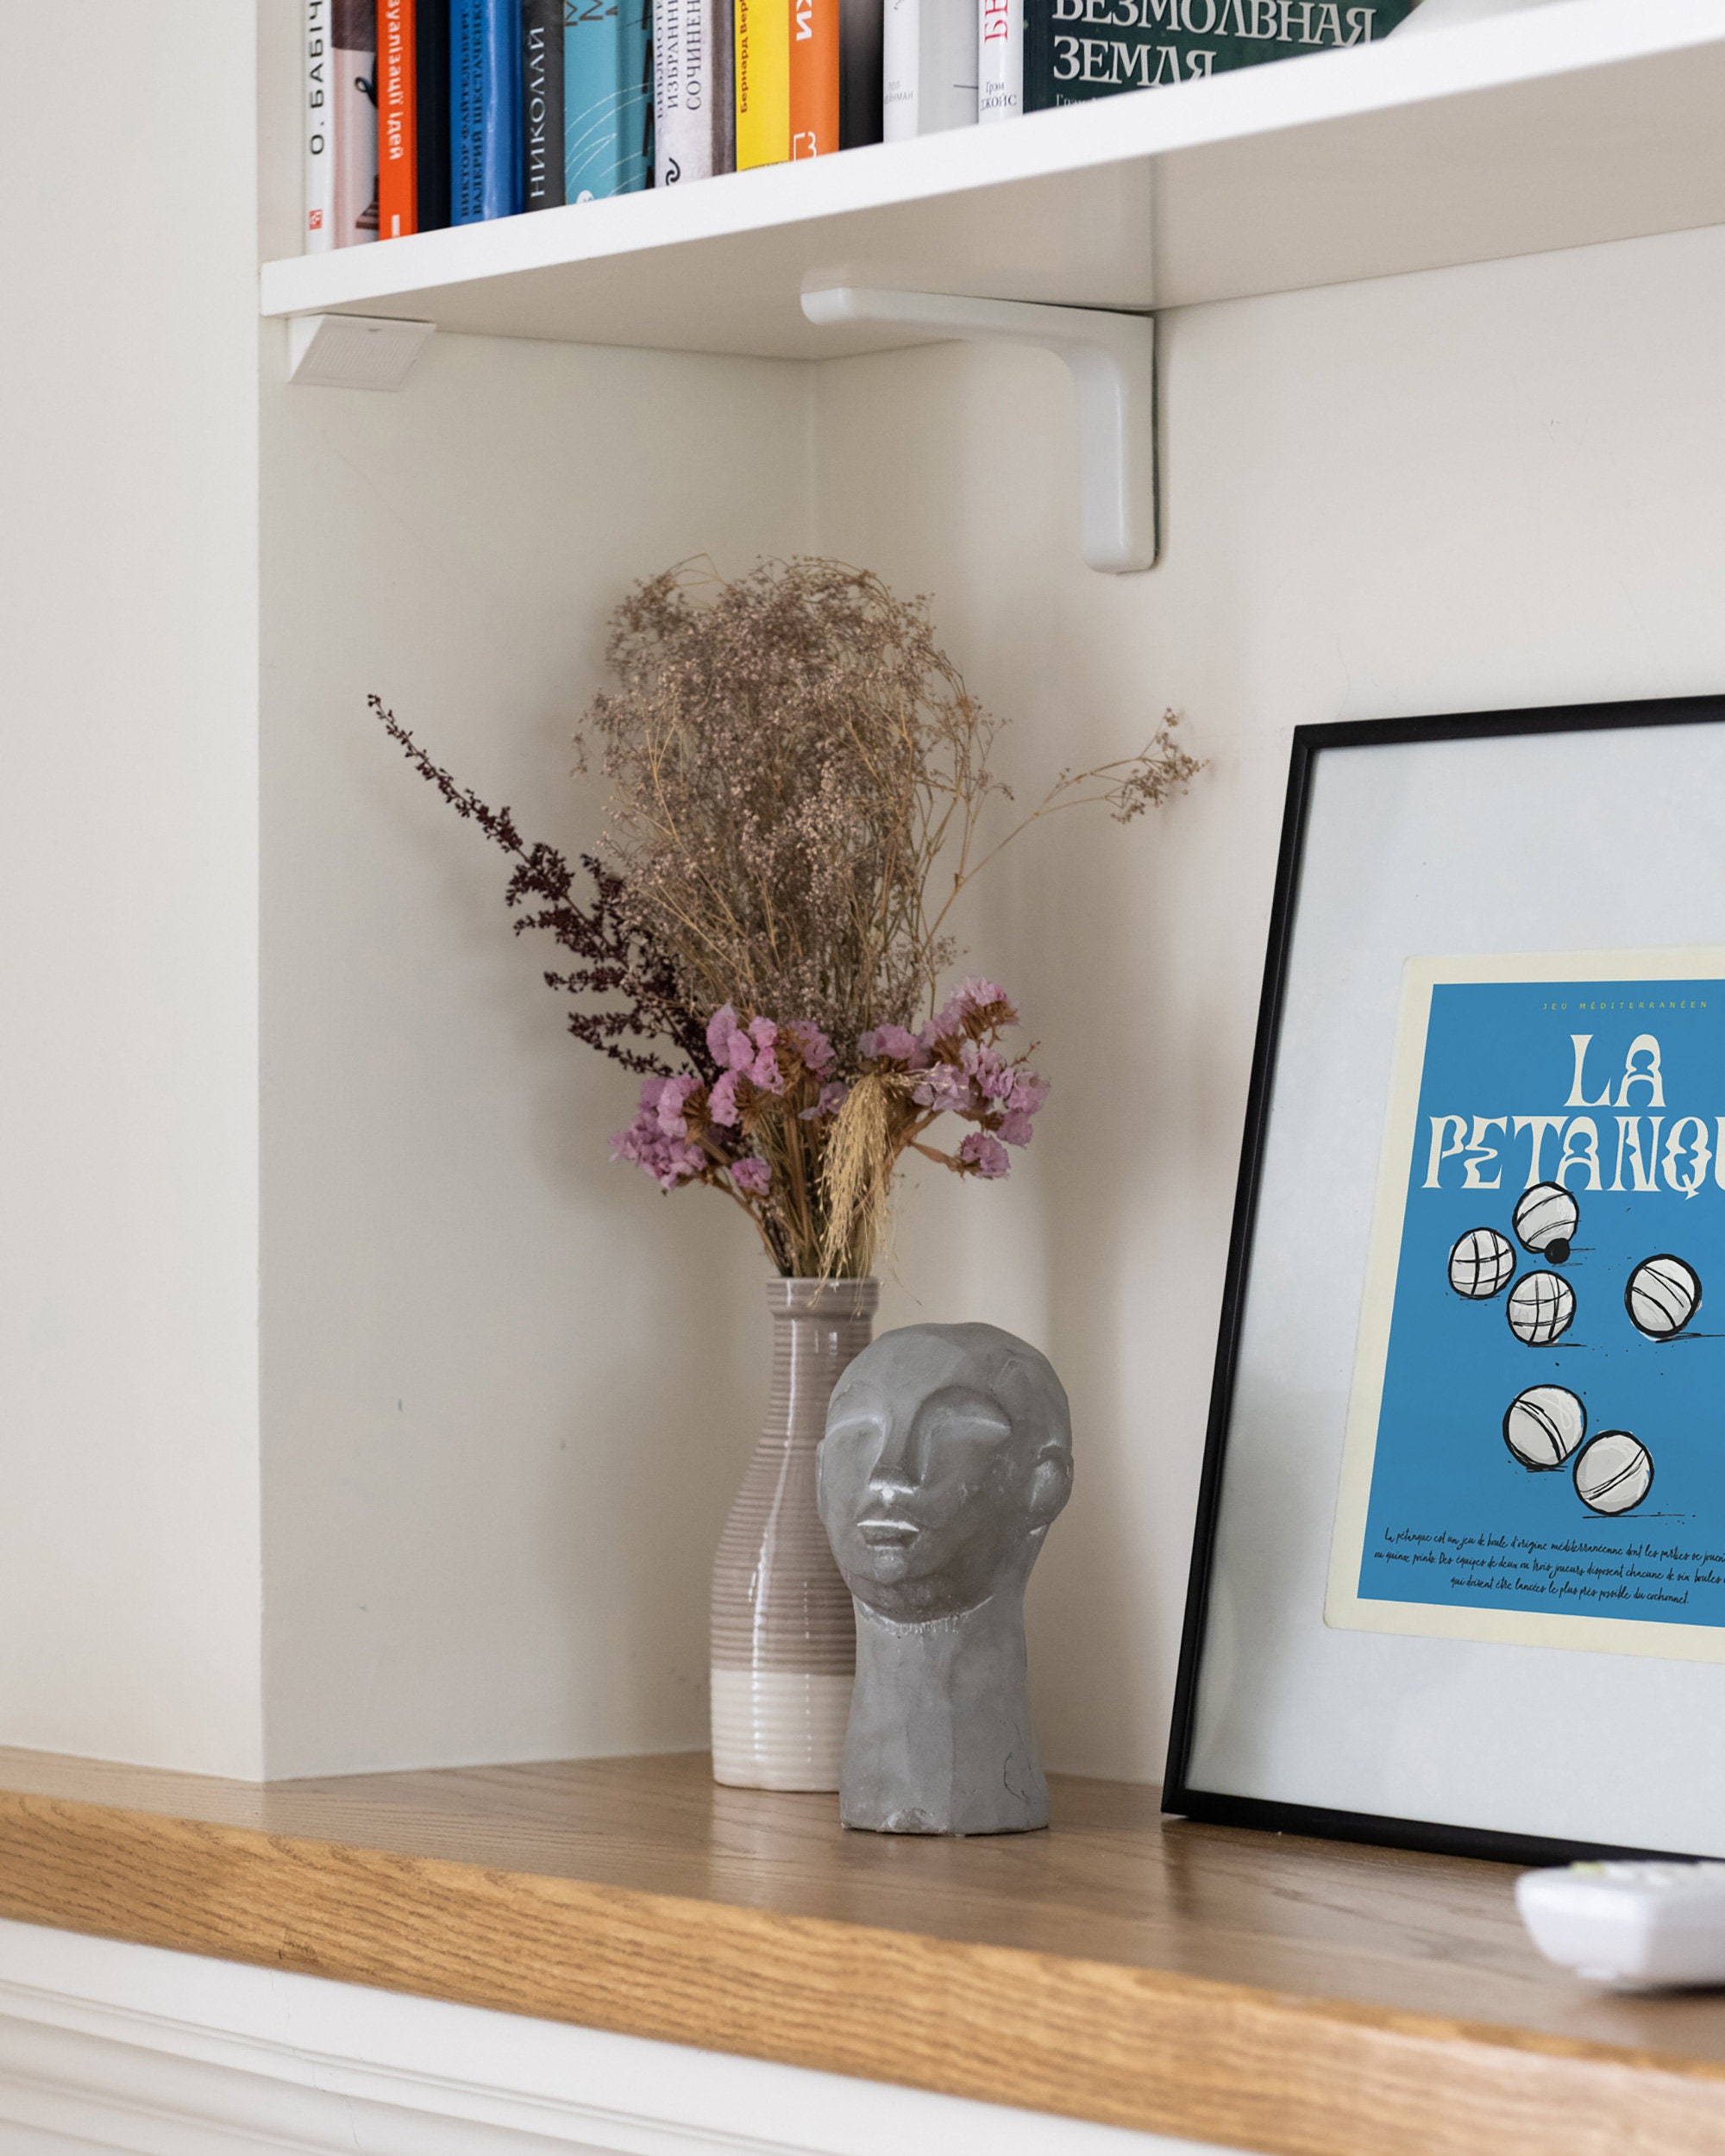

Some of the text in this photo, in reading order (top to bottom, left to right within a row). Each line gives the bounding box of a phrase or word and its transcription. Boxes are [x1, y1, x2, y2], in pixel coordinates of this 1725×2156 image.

[309, 1, 325, 109] БАБІЧ
[739, 0, 750, 114] Бернард Вер
[1053, 35, 1217, 86] ЗЕМЛЯ
[386, 113, 405, 160] ідей
[528, 27, 546, 198] НИКОЛАЙ
[461, 142, 470, 217] ВИКТОР
[472, 132, 483, 216] ВАЛЕРИЙ
[1579, 1000, 1708, 1010] MÉDITERRANÉEN
[1562, 1034, 1667, 1107] LA
[1421, 1114, 1725, 1200] PETANQ
[1396, 1527, 1433, 1545] pétanque
[1433, 1531, 1446, 1544] est
[1456, 1537, 1476, 1551] jeu
[1477, 1533, 1485, 1546] de
[1487, 1532, 1508, 1548] boule
[1550, 1539, 1623, 1556] méditerranéenne
[1626, 1544, 1642, 1557] dont
[1645, 1544, 1659, 1558] les
[1659, 1545, 1690, 1562] parties
[1439, 1551, 1454, 1564] Des
[1456, 1554, 1486, 1570] équipes
[1487, 1556, 1498, 1569] de
[1498, 1556, 1517, 1570] deux
[1533, 1557, 1552, 1571] trois
[1548, 1564, 1584, 1579] joueurs
[1586, 1562, 1625, 1580] disposent
[1625, 1564, 1664, 1580] chacune
[1666, 1567, 1674, 1581] de
[1677, 1572, 1690, 1582] six
[1694, 1567, 1722, 1584] boules
[1450, 1576, 1465, 1588] qui
[1465, 1574, 1494, 1590] doivent
[1548, 1581, 1559, 1594] le
[1559, 1581, 1578, 1598] plus
[1598, 1584, 1631, 1601] possible
[1634, 1587, 1646, 1600] du
